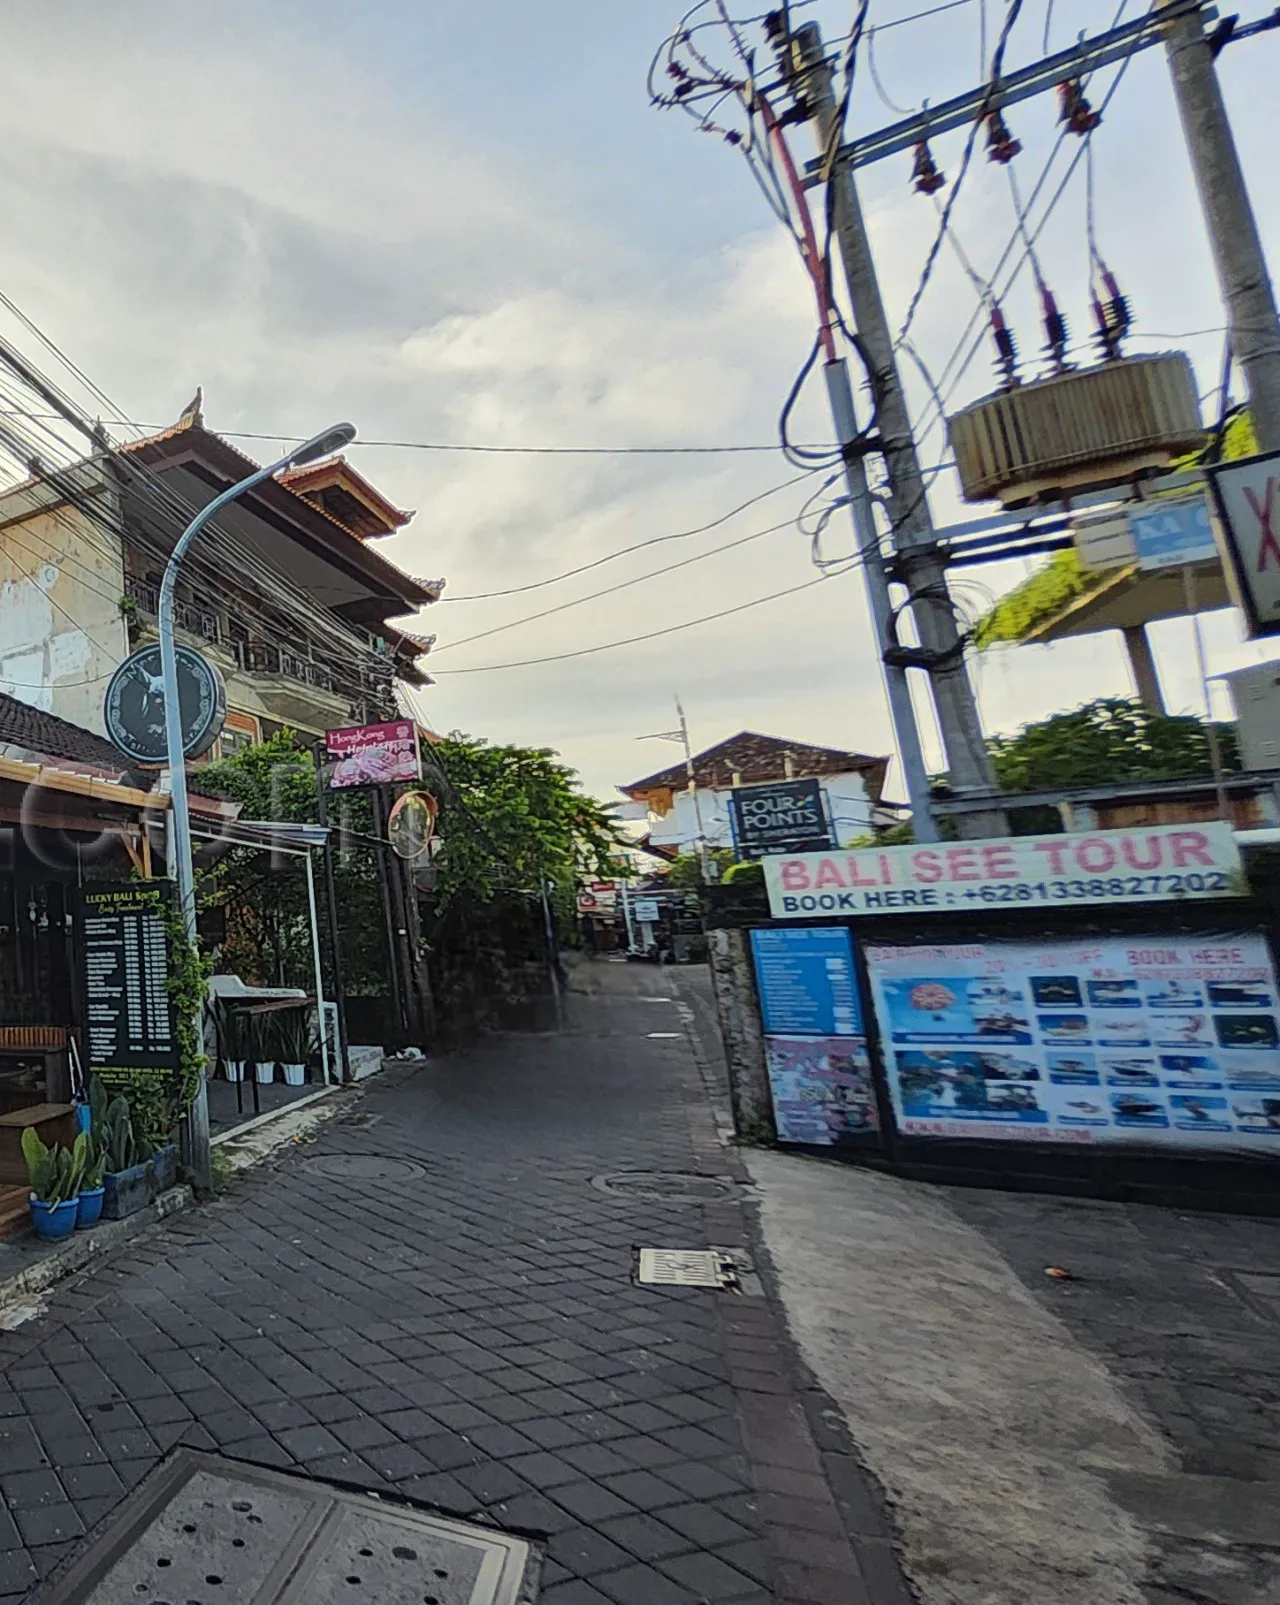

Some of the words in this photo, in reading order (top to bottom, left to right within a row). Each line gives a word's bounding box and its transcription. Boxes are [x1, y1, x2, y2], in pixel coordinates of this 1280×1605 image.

[741, 796, 797, 815] FOUR
[743, 809, 819, 829] POINTS
[779, 854, 893, 892] BALI
[911, 845, 1020, 884] SEE
[1033, 831, 1217, 876] TOUR
[782, 891, 857, 912] BOOK
[864, 887, 938, 908] HERE
